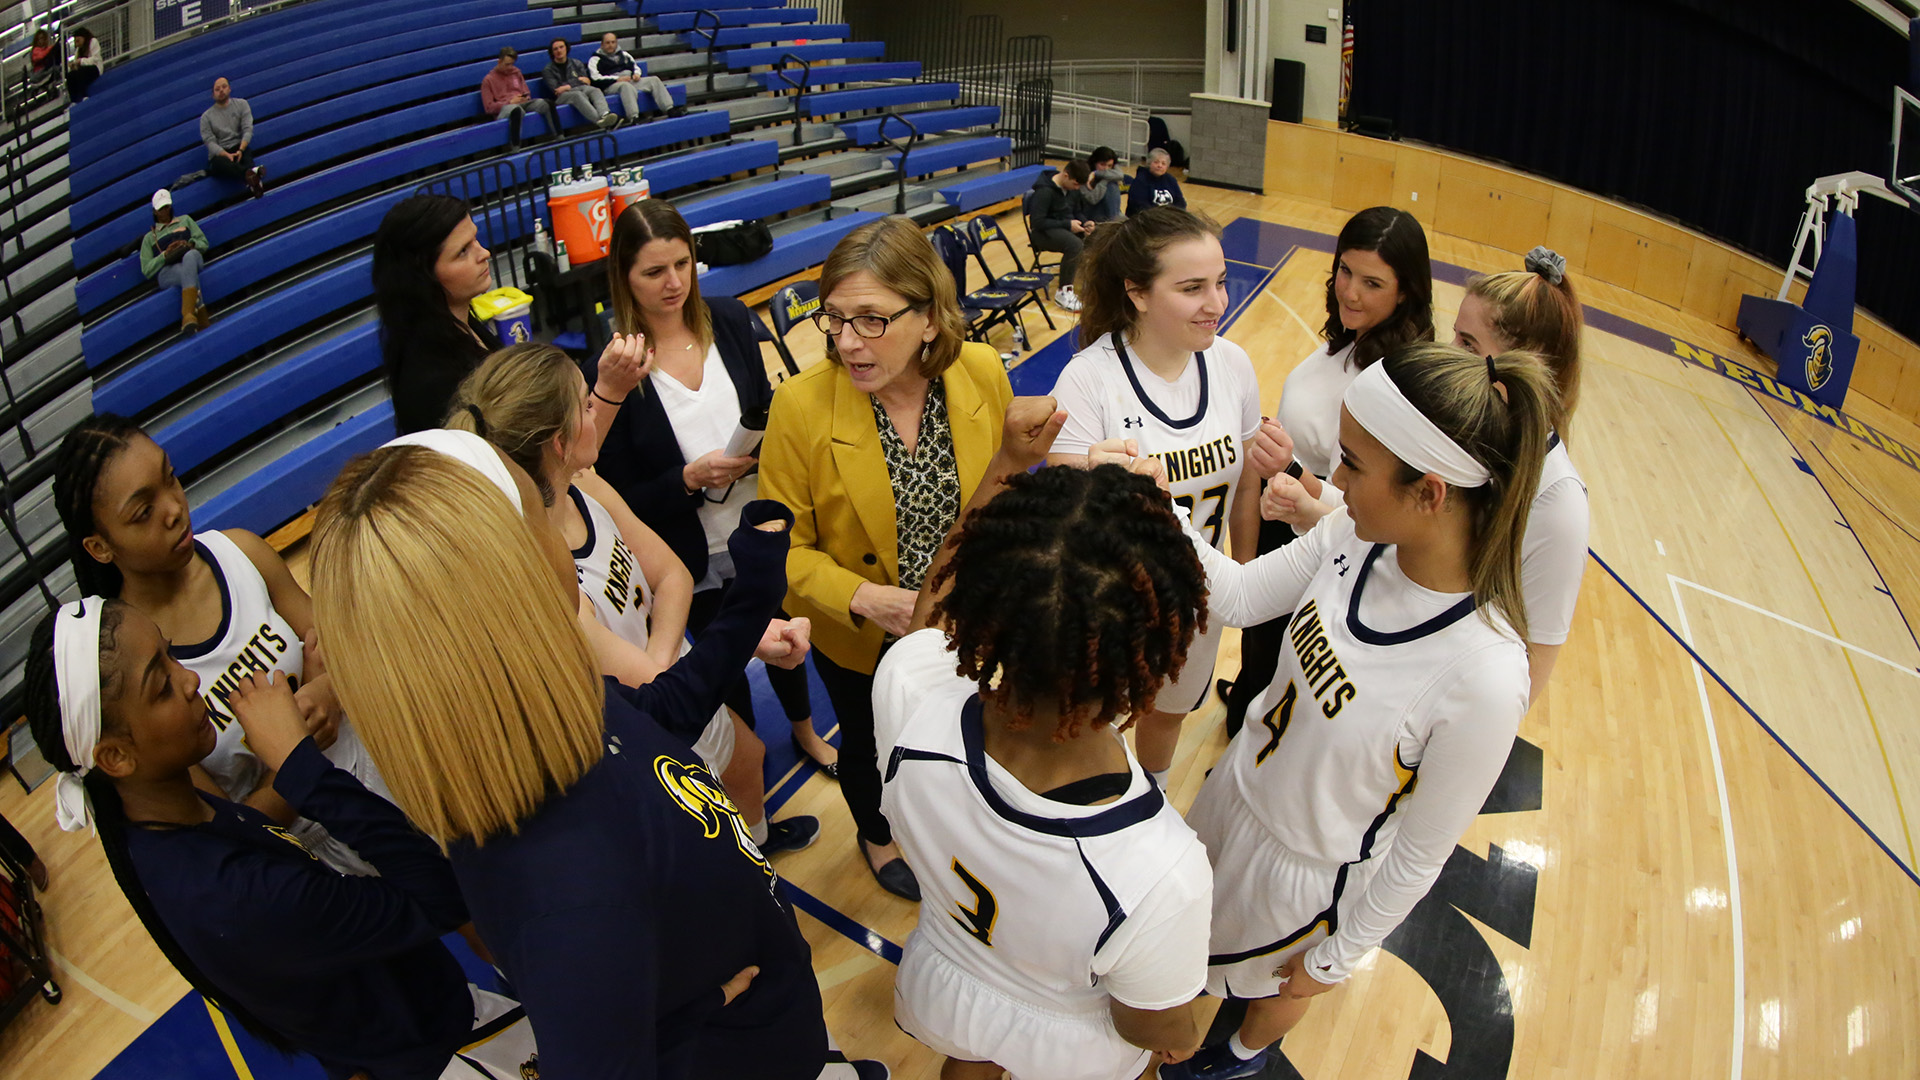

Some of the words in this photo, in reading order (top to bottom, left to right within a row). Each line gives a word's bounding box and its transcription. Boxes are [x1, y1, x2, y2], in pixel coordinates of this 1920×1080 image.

[182, 1, 202, 27] E
[592, 201, 607, 221] G
[1148, 435, 1236, 483] NIGHTS
[1289, 598, 1356, 720] KNIGHTS
[1255, 677, 1299, 769] 4
